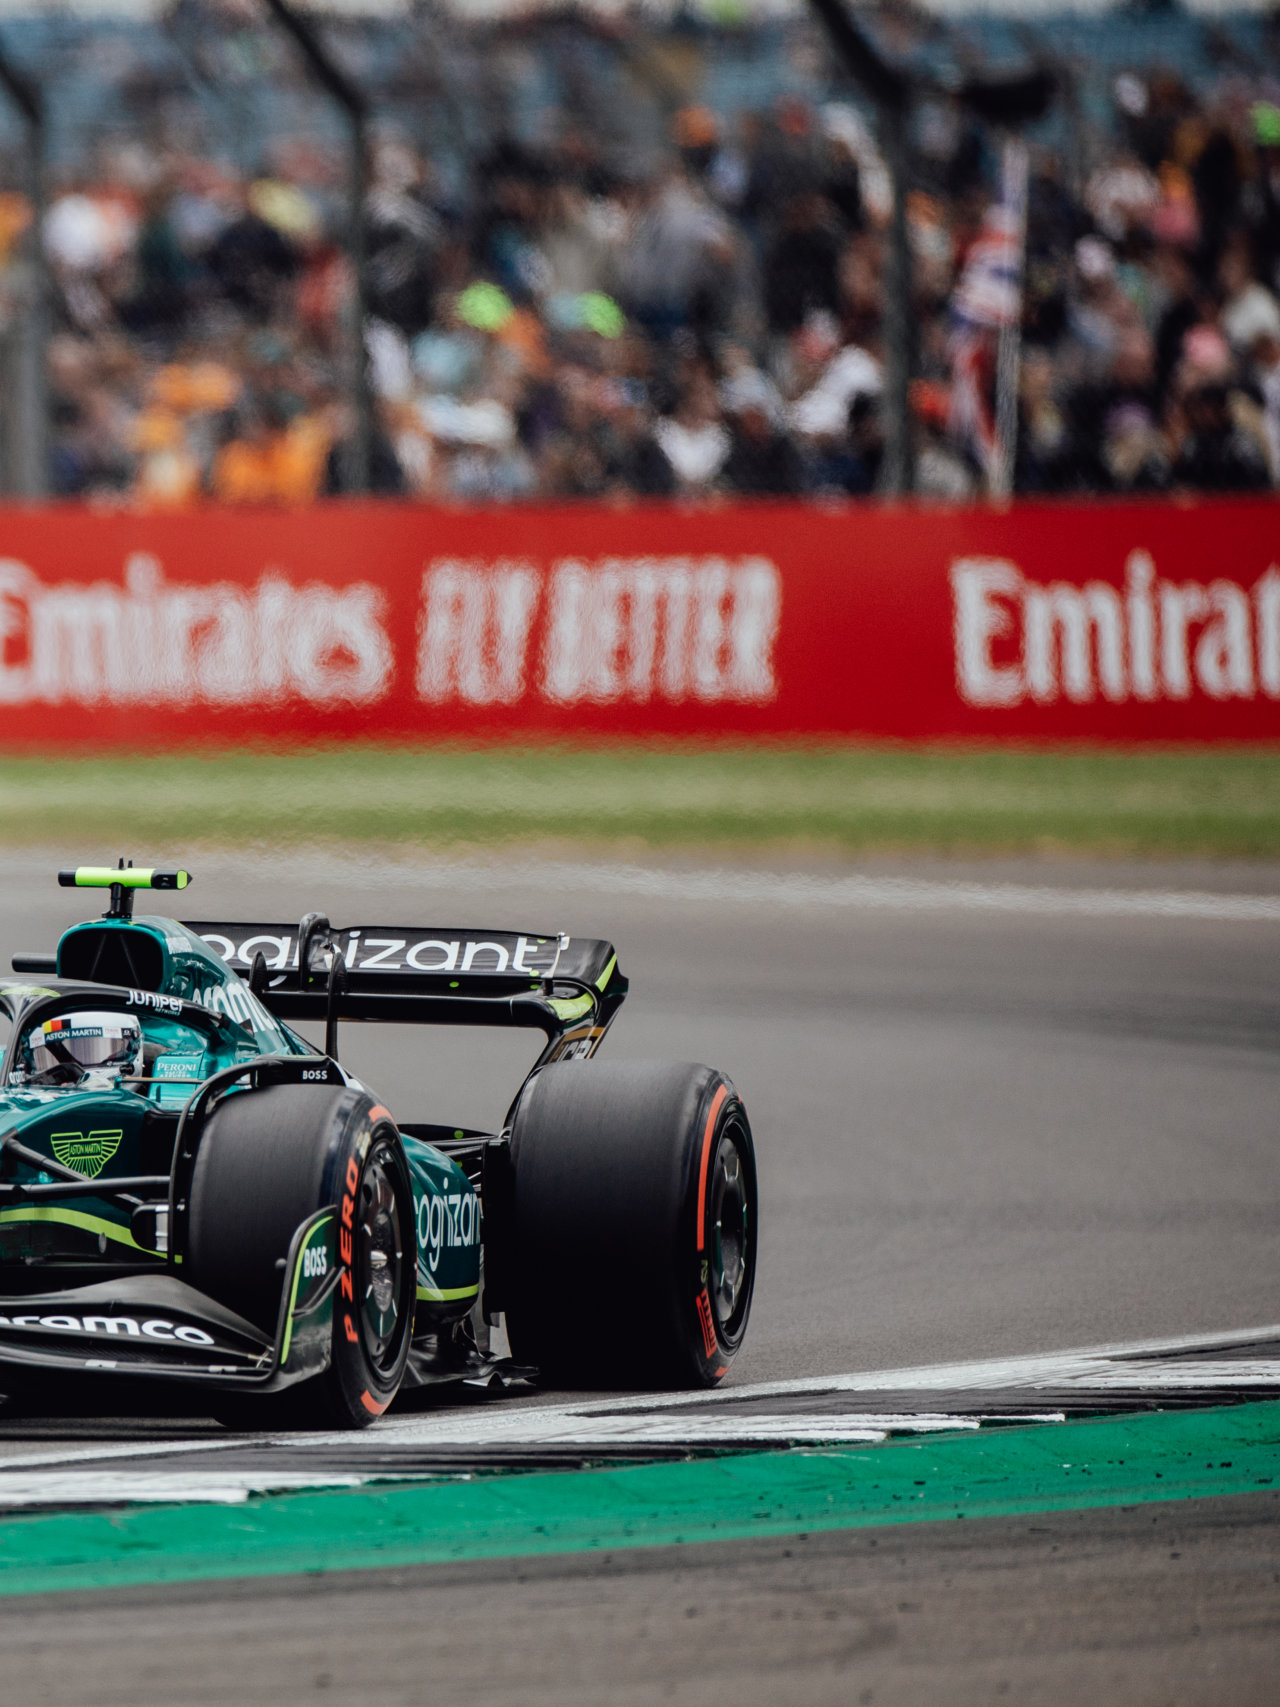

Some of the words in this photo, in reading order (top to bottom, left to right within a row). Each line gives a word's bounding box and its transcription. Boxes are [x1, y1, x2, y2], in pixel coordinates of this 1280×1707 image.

[416, 556, 539, 705] FLY
[540, 556, 781, 706] BETTER
[46, 1031, 70, 1041] ASTON
[72, 1028, 101, 1037] MARTIN
[157, 1063, 196, 1071] PERONI
[302, 1070, 328, 1080] BOSS
[71, 1145, 83, 1154] ASTON
[85, 1143, 101, 1153] MARTIN
[340, 1157, 360, 1302] ZERO
[413, 1177, 480, 1272] ognizan
[304, 1246, 327, 1277] BOSS
[344, 1314, 358, 1343] P
